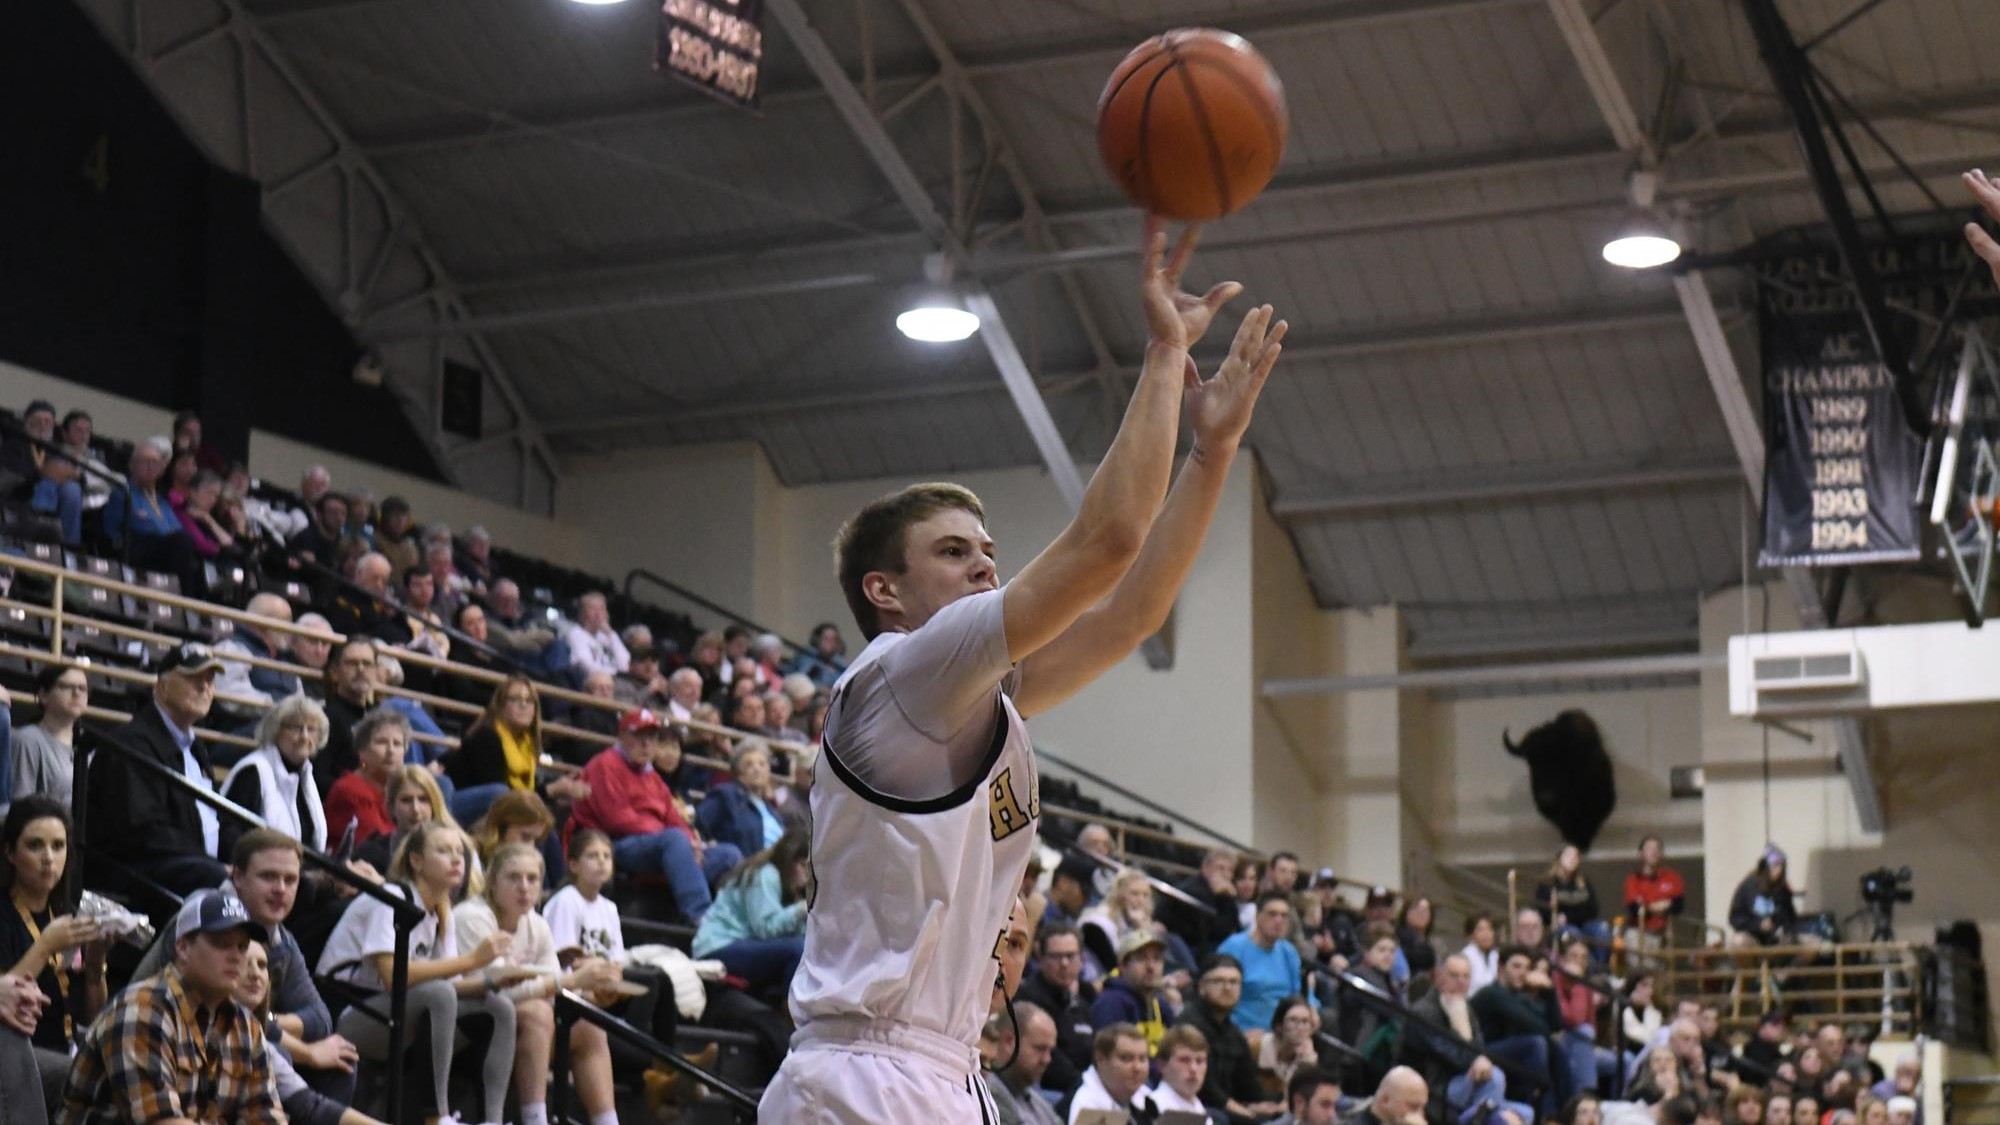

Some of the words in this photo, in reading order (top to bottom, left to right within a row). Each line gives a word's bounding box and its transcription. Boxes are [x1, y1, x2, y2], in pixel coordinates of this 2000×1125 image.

[1811, 396, 1868, 422] 1989
[1811, 427, 1868, 454] 1990
[1815, 458, 1863, 485] 1991
[1811, 488, 1869, 517] 1993
[1811, 520, 1868, 549] 1994
[989, 754, 1040, 842] H
